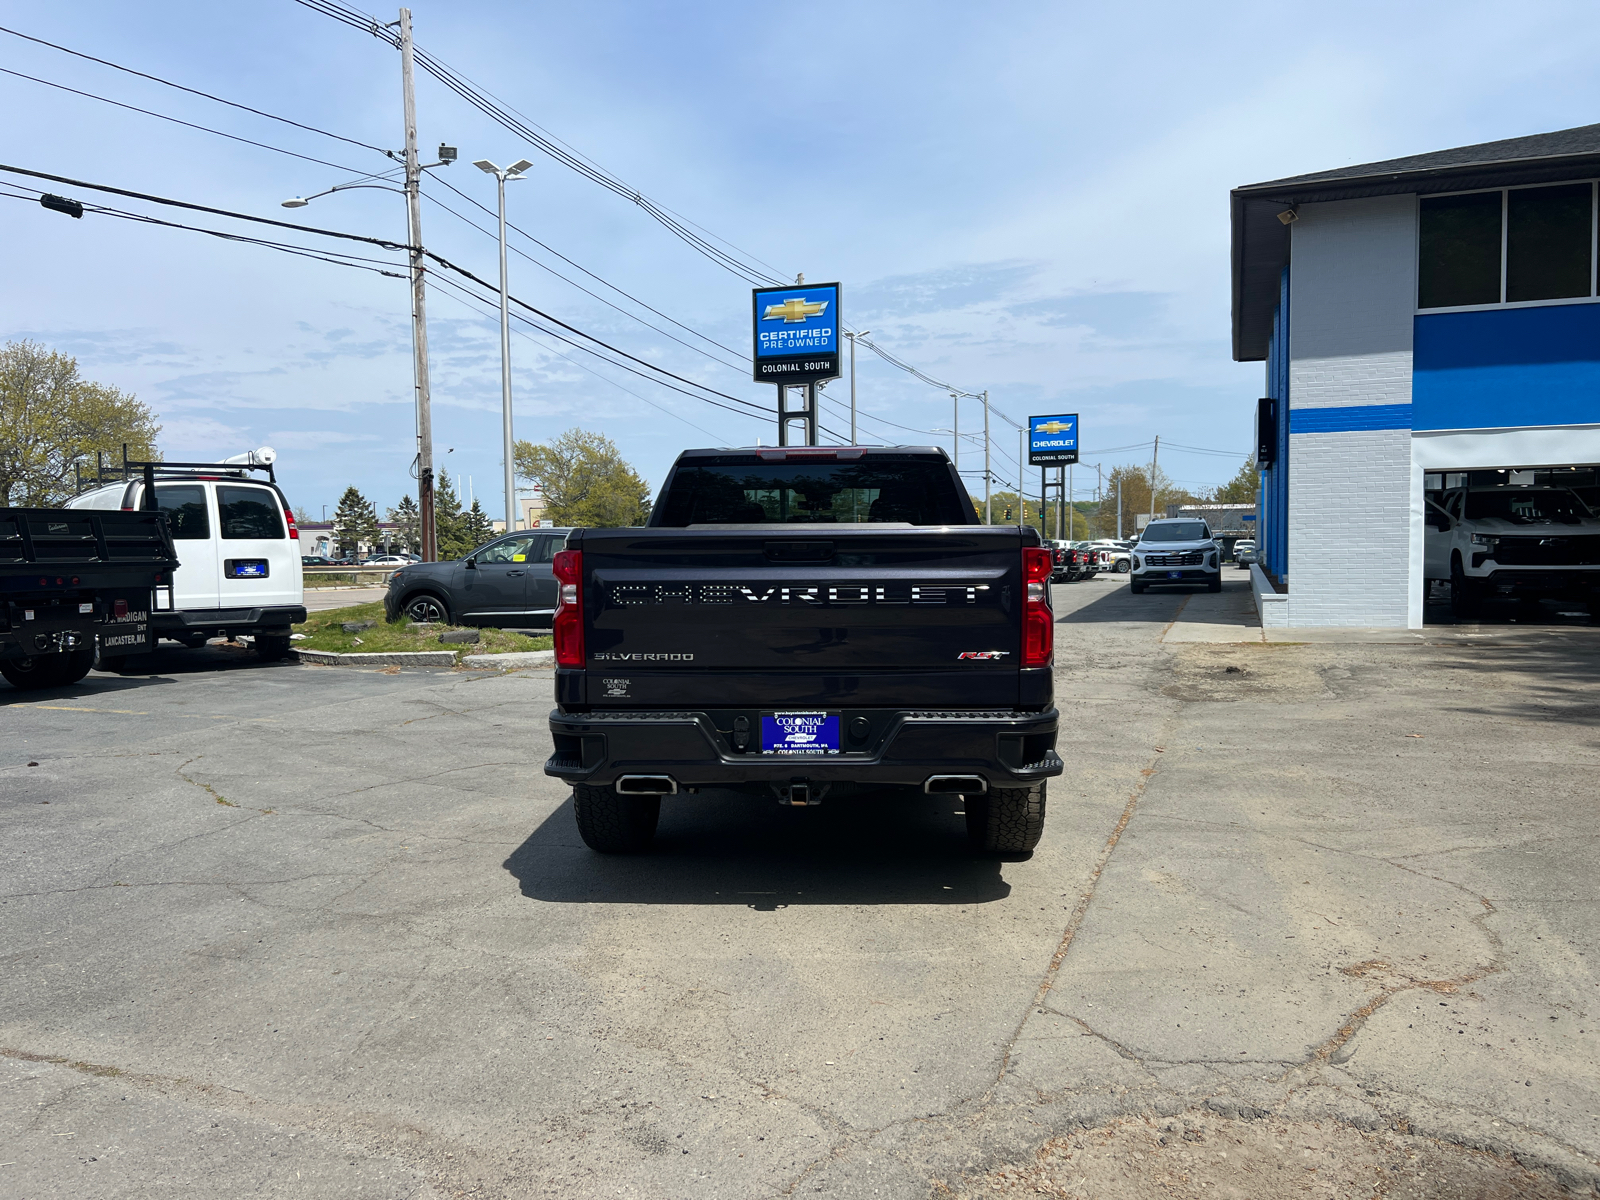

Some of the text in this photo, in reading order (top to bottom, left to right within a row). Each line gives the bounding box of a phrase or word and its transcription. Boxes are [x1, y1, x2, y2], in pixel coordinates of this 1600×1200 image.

[760, 328, 832, 341] CERTIFIED
[763, 337, 828, 349] PRE-OWNED
[762, 361, 830, 373] COLONIAL SOUTH
[1032, 439, 1075, 448] CHEVROLET
[613, 584, 990, 604] CHEVROLET
[957, 651, 1010, 660] RST
[776, 718, 824, 726] COLONIAL
